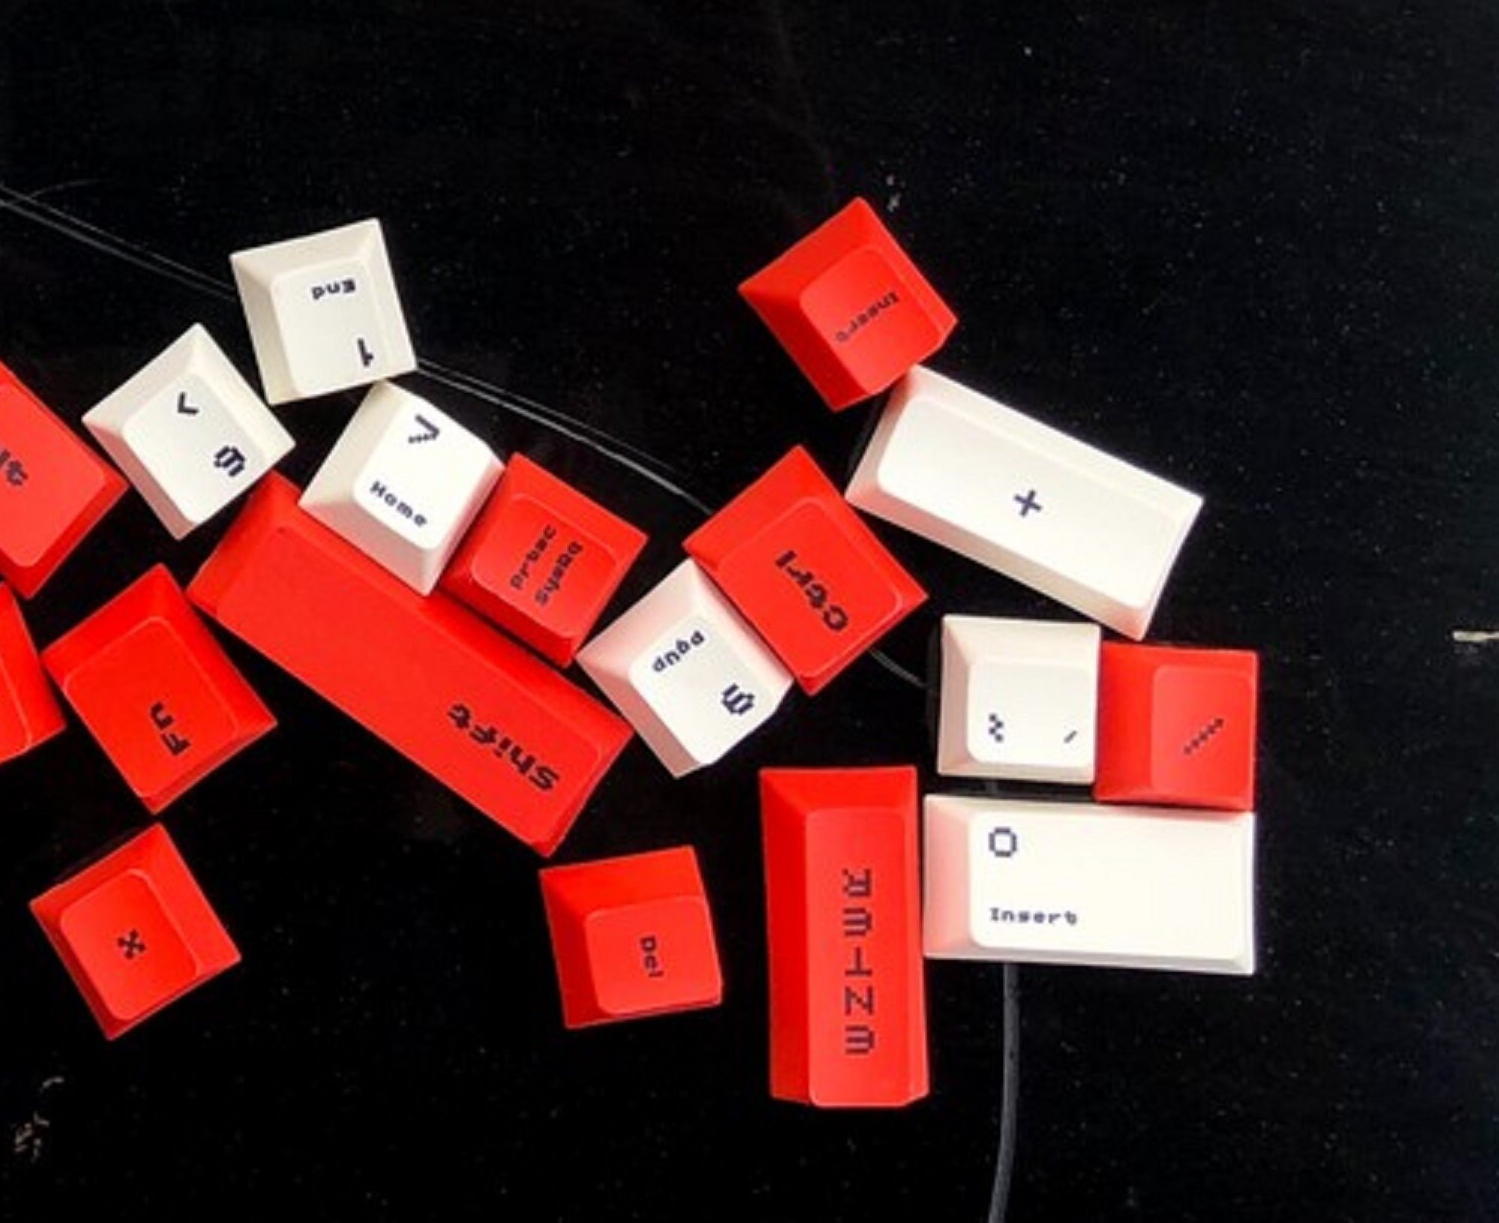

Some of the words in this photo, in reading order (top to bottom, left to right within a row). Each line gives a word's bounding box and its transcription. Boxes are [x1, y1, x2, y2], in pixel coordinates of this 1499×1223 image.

[312, 279, 356, 299] End
[832, 292, 900, 346] Insert
[358, 339, 373, 366] 1
[369, 480, 427, 527] Home
[1014, 490, 1041, 516] +
[776, 551, 848, 631] Ctrl
[654, 631, 704, 672] PgUp
[149, 702, 190, 756] Fn
[447, 703, 560, 792] Shift
[991, 908, 1077, 925] Insert
[641, 936, 663, 977] Del
[843, 869, 874, 1054] ENTER
